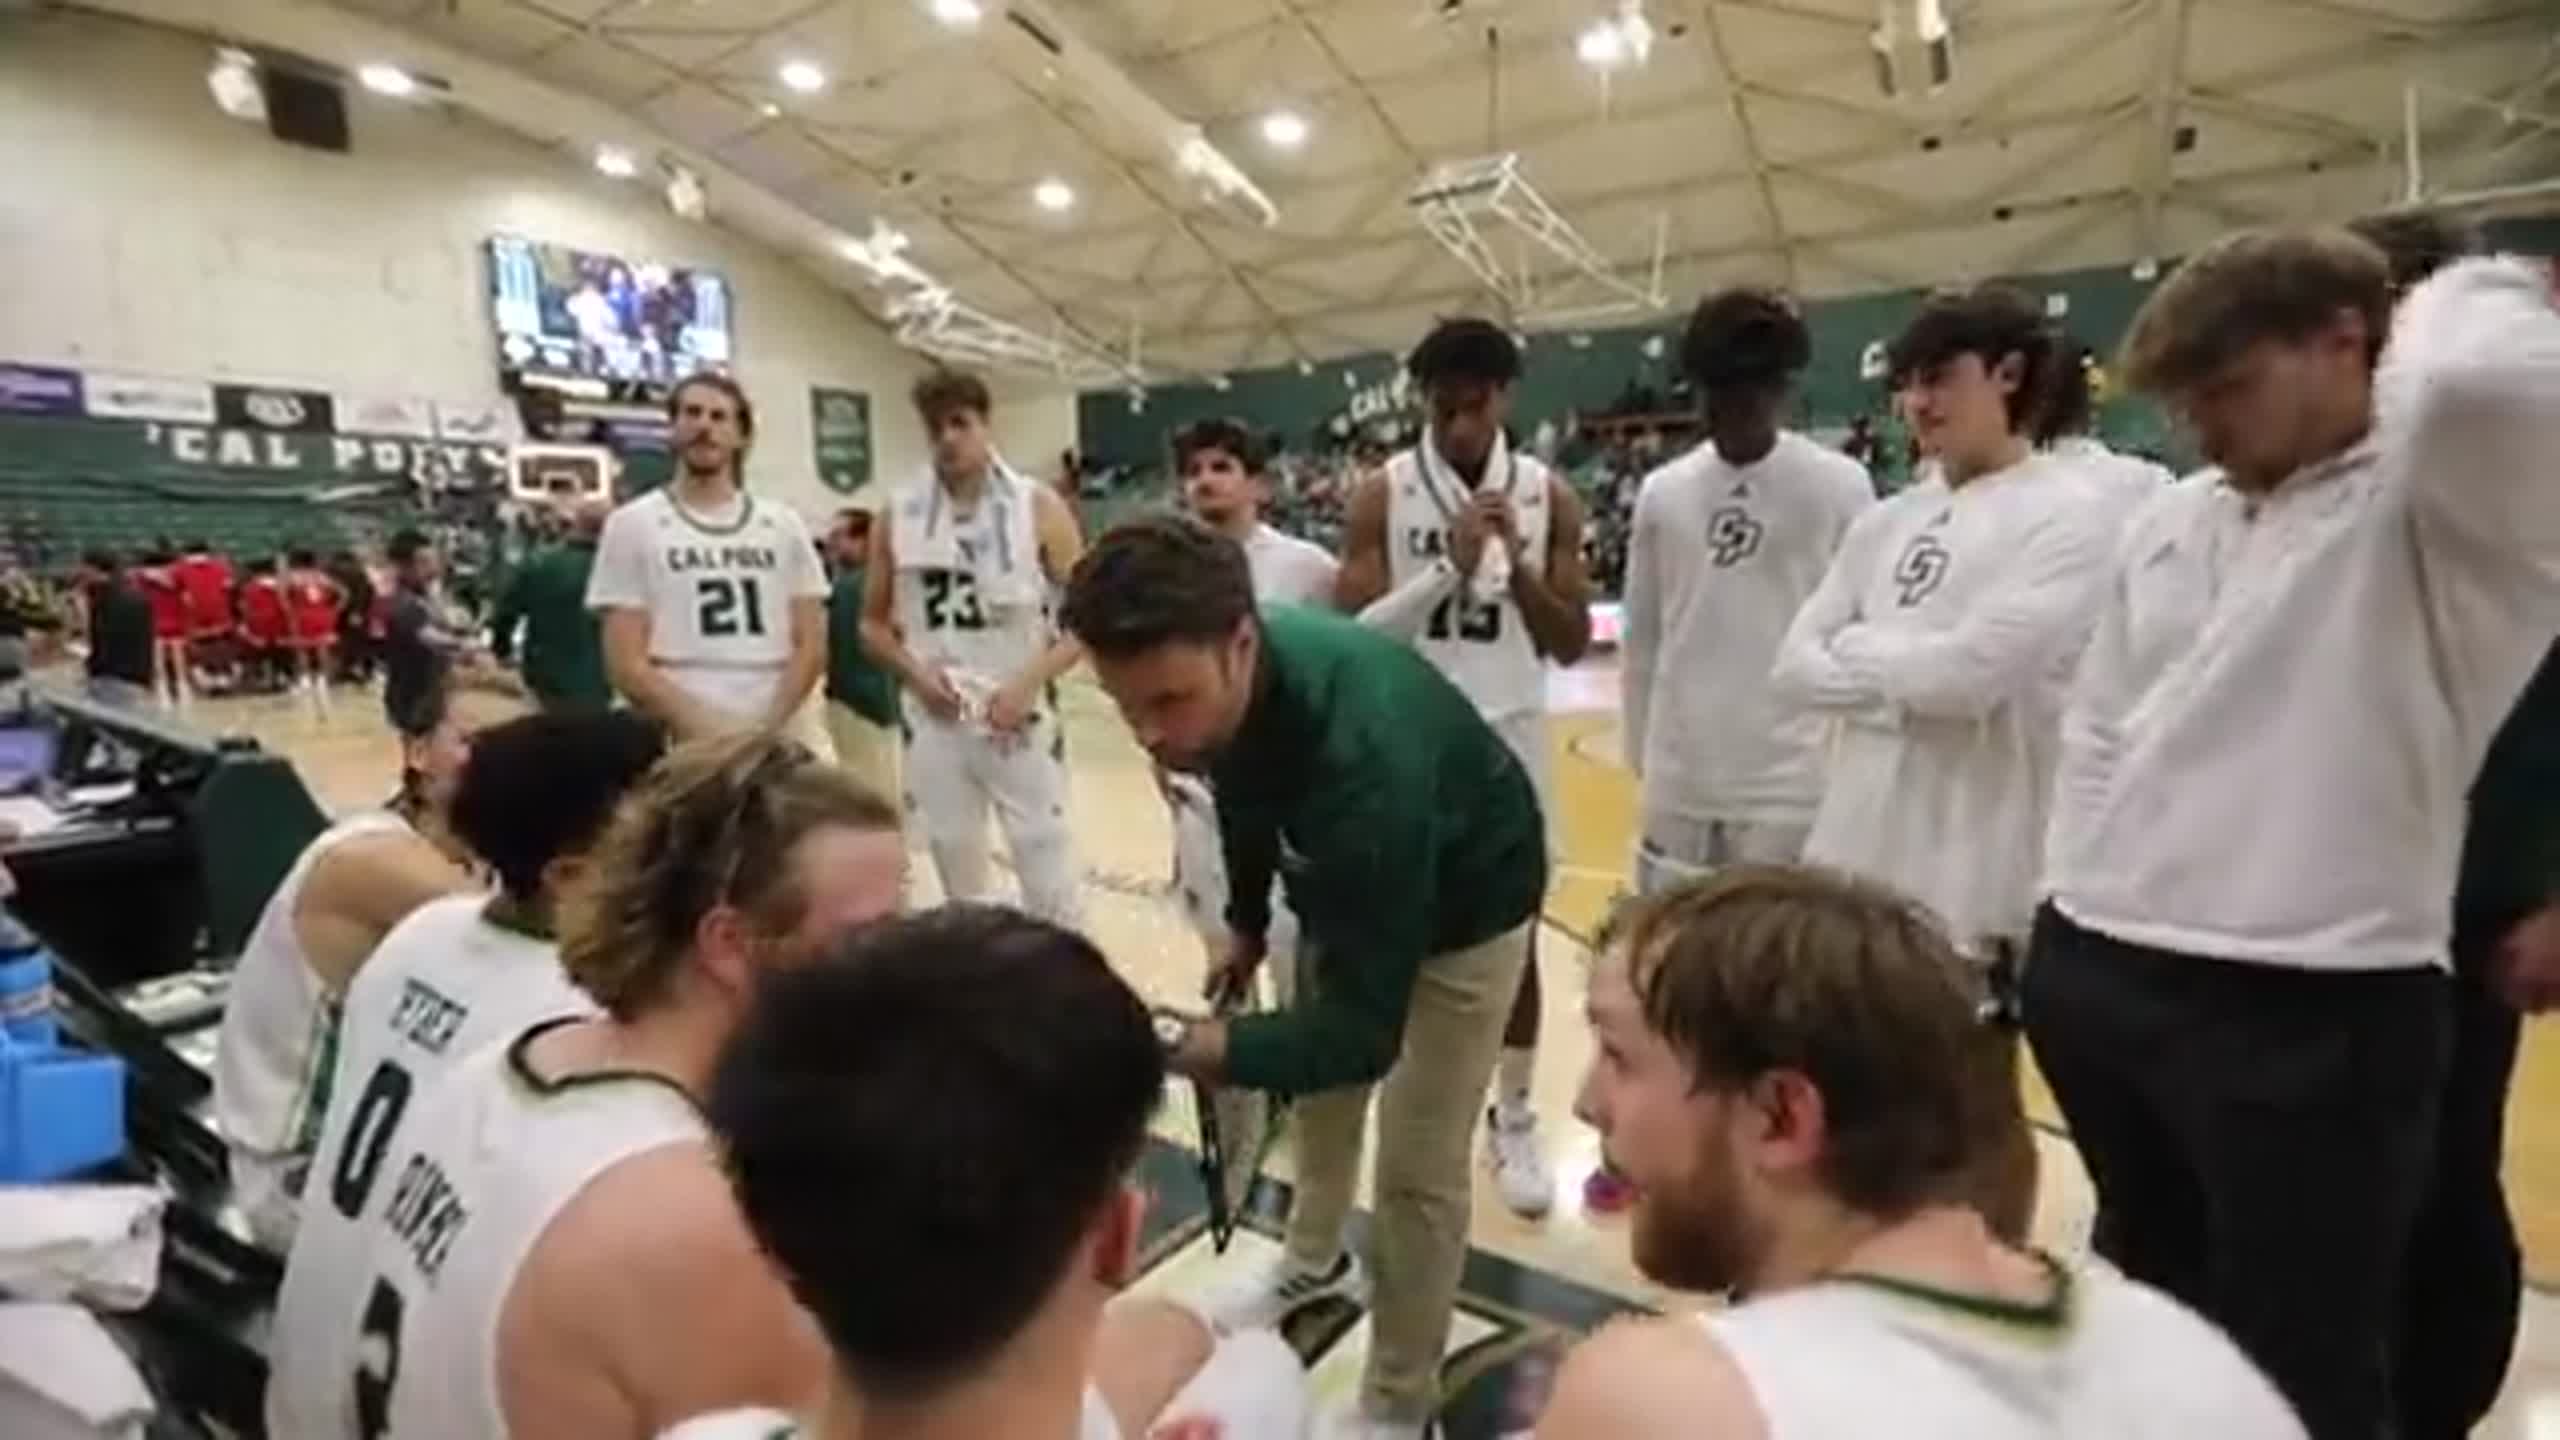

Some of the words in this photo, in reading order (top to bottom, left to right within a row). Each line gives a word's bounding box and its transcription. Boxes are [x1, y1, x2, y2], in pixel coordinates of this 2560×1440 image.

[173, 430, 302, 468] CAL
[667, 547, 717, 571] CAL
[1409, 526, 1454, 557] CA
[697, 578, 765, 637] 21
[921, 569, 987, 630] 23
[331, 1058, 413, 1220] 0
